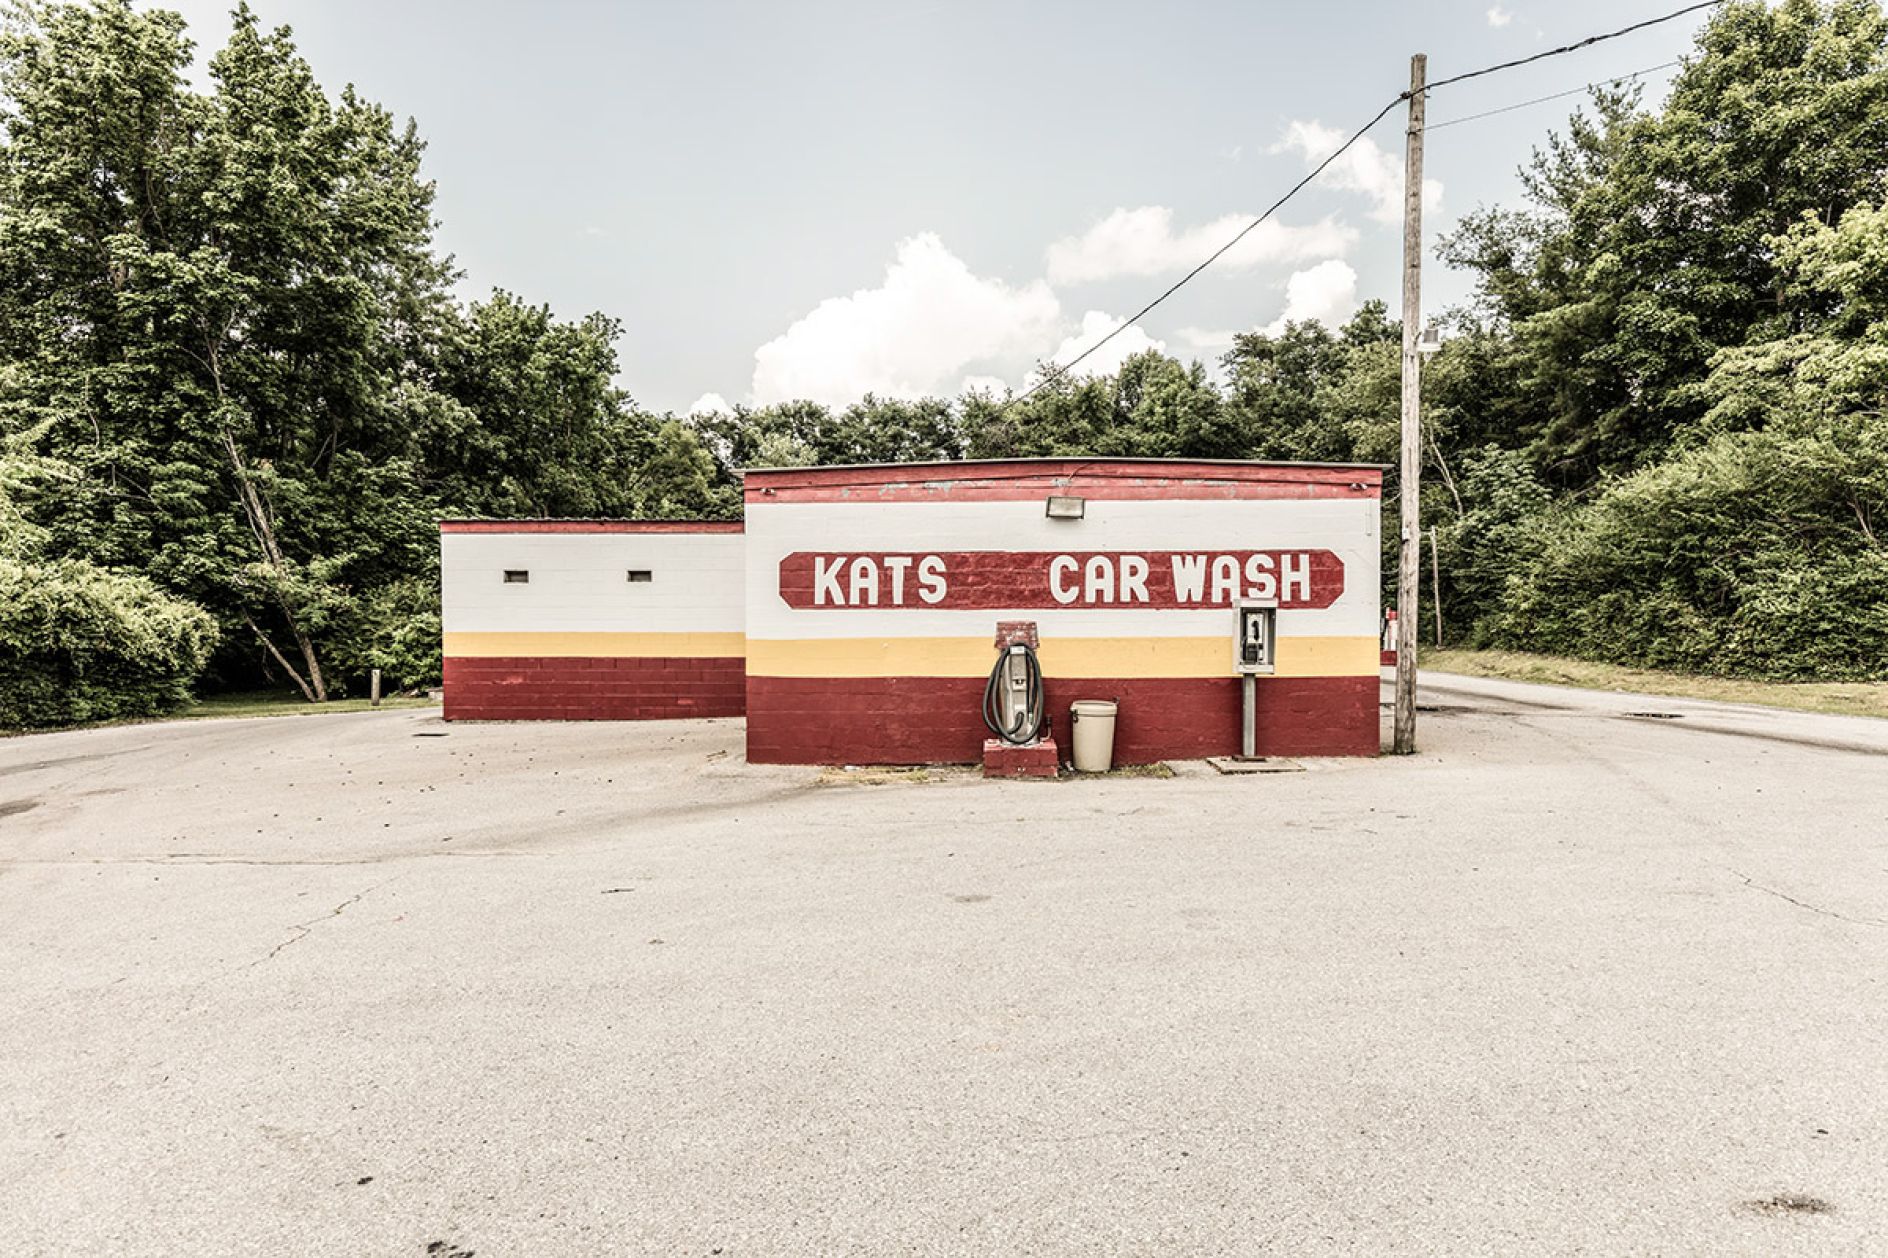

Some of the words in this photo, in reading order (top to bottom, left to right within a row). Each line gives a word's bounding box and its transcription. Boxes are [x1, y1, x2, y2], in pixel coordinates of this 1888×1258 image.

[814, 555, 947, 604] KATS
[1050, 554, 1149, 605] CAR
[1171, 554, 1311, 603] WASH
